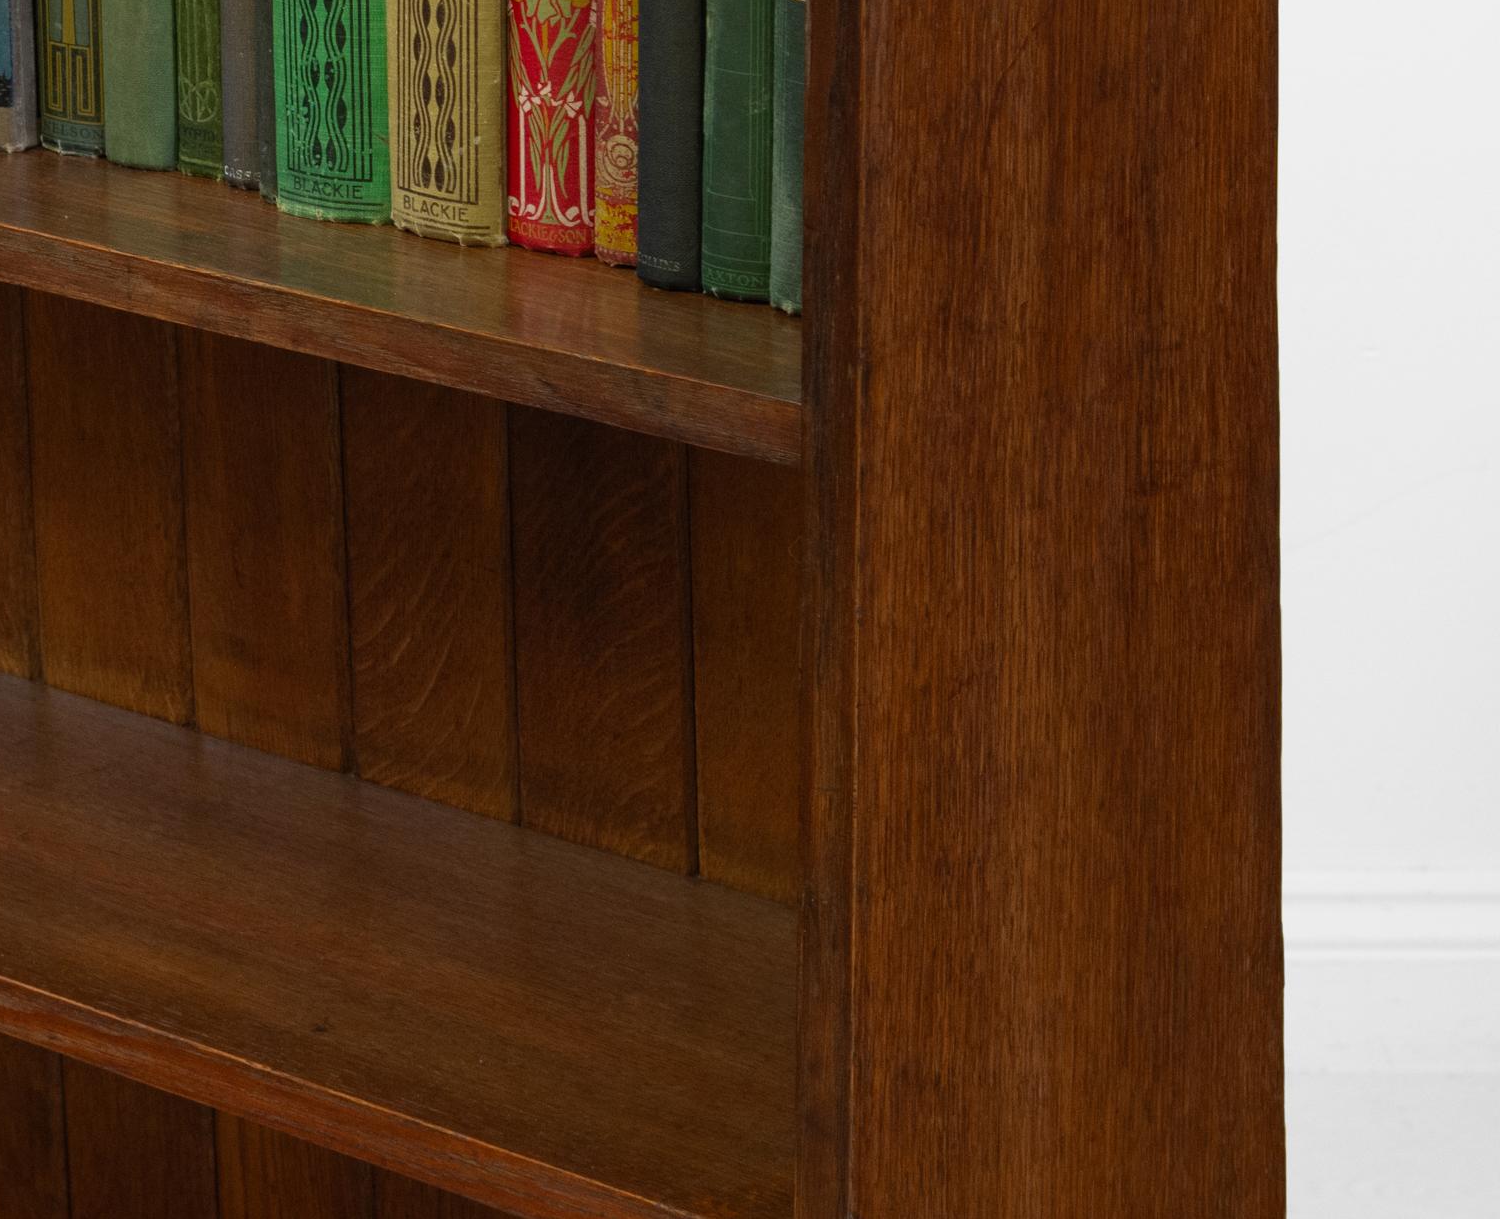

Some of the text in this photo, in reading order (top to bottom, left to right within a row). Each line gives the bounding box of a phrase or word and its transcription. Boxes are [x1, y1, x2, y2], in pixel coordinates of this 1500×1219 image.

[224, 165, 260, 181] CASSE
[293, 175, 363, 199] BLACKIE
[403, 195, 470, 222] BLACKIE
[705, 267, 764, 287] AXTON
